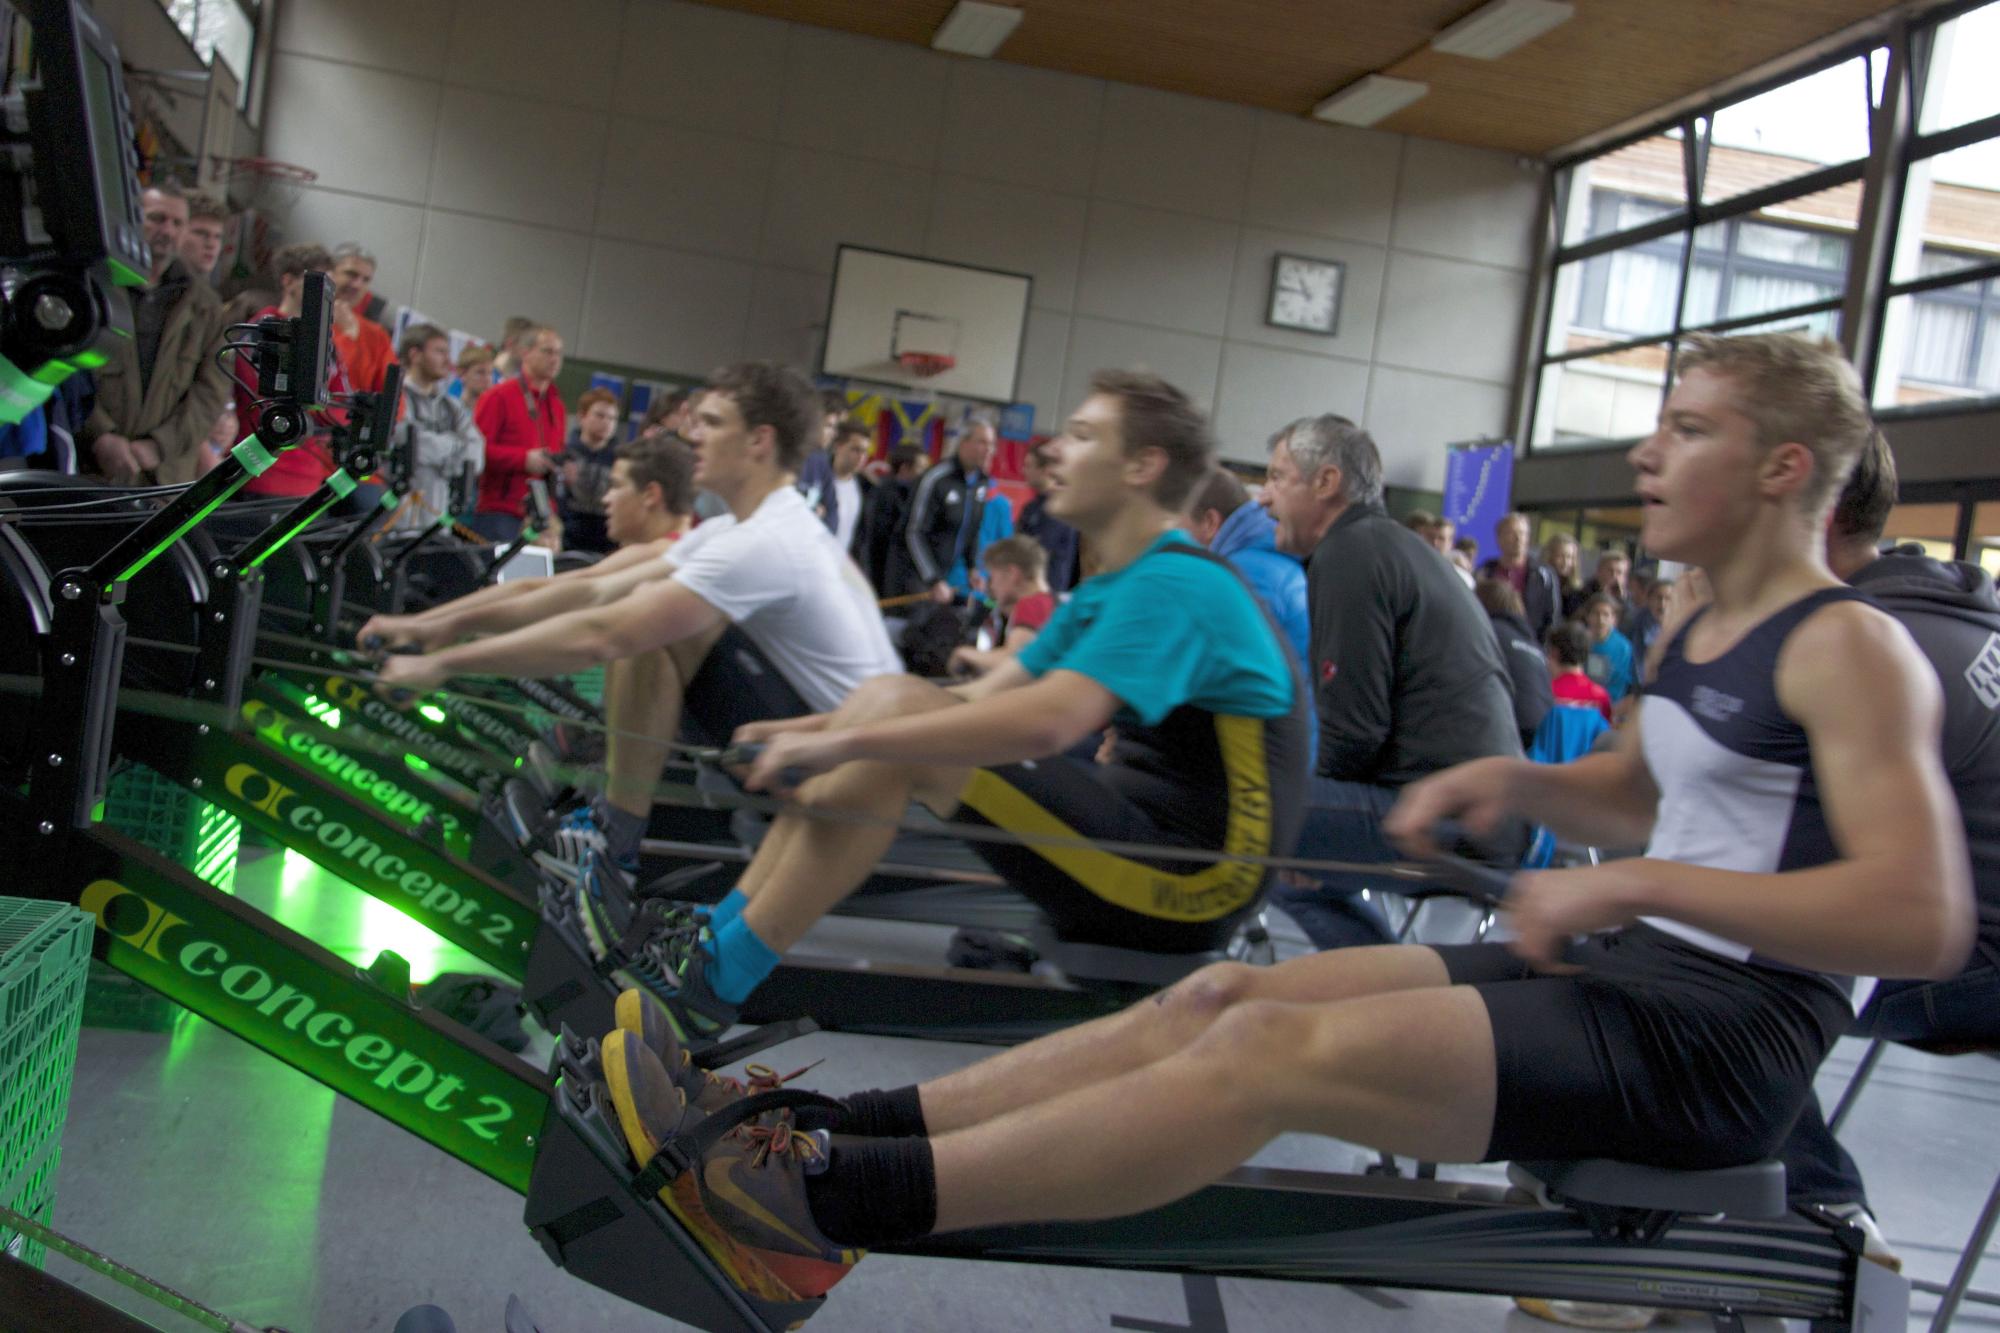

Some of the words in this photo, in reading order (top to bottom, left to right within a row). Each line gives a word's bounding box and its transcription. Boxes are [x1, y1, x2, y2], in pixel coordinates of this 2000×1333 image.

[289, 732, 437, 824] concept
[364, 700, 481, 777] concept
[290, 805, 481, 926] concept
[479, 914, 514, 945] 2
[179, 940, 469, 1112] concept
[458, 1094, 514, 1140] 2
